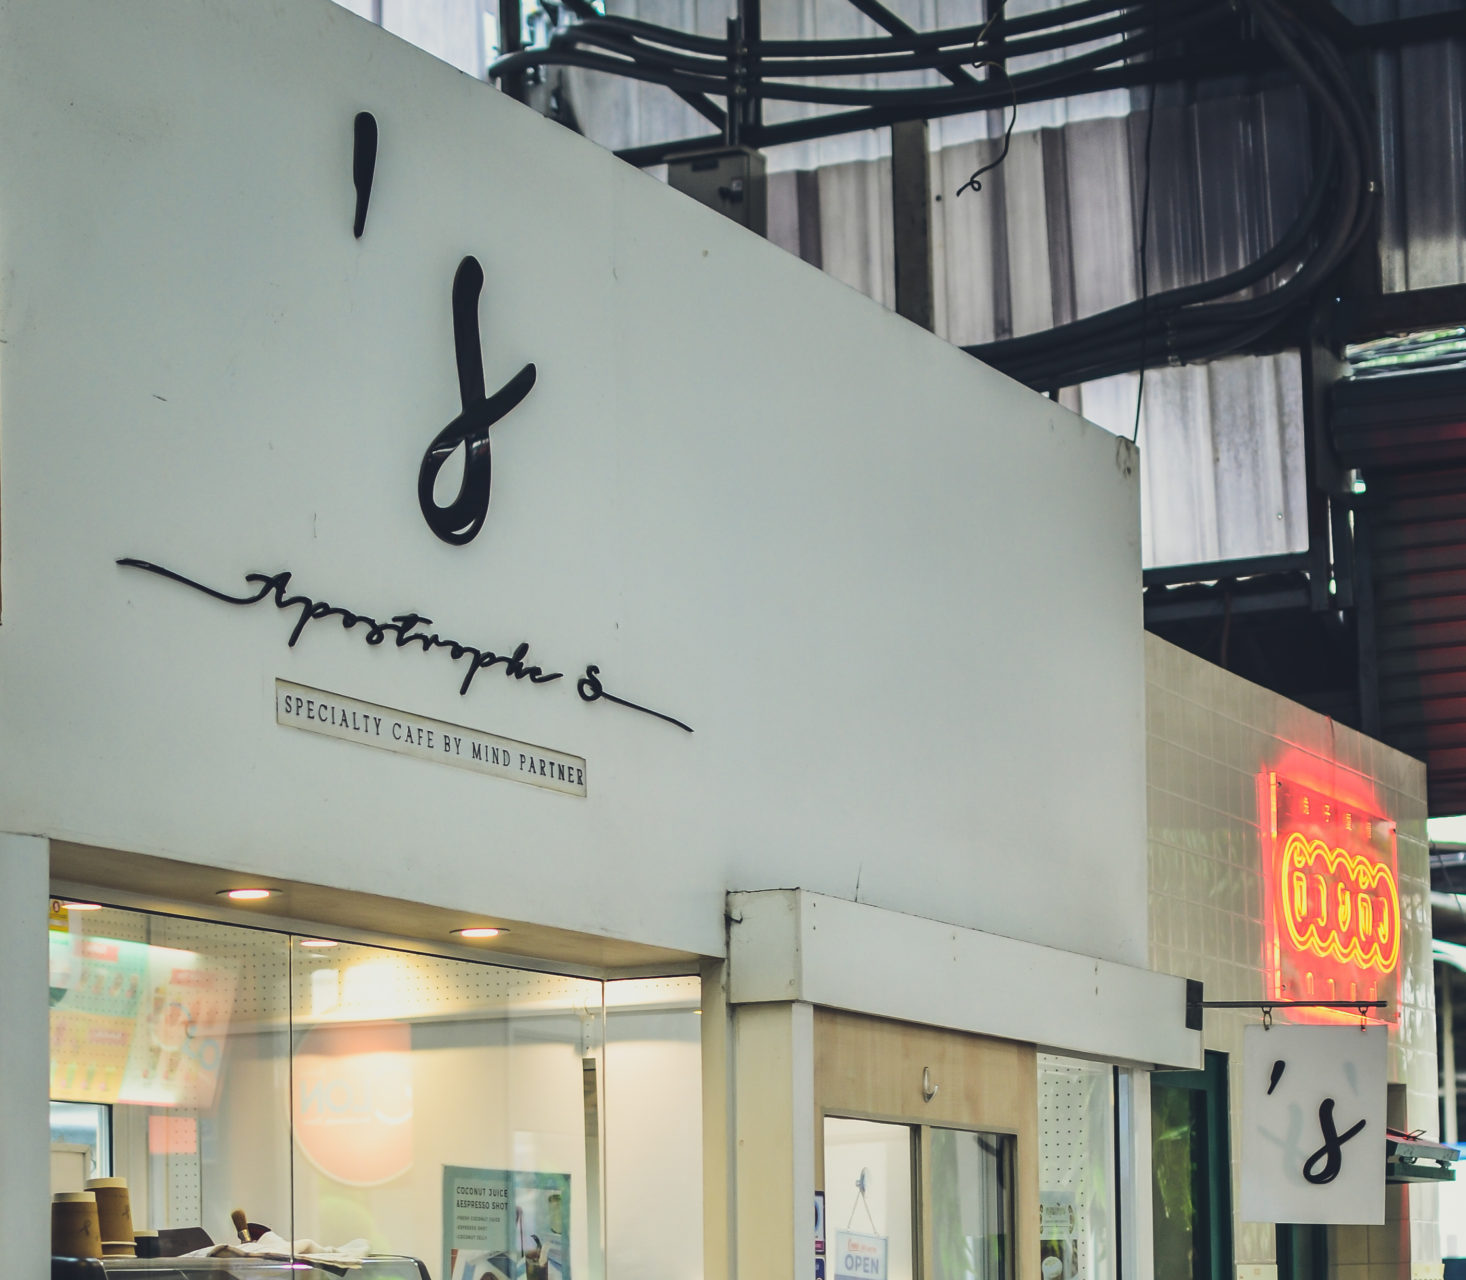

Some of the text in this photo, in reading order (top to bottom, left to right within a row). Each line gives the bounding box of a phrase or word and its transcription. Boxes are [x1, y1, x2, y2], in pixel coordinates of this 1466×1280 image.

[115, 557, 564, 696] Apostrophe
[285, 694, 584, 786] SPECIALTY CAFE BY MIND PARTNER
[456, 1187, 508, 1198] COCONUT JUICE
[456, 1200, 508, 1211] &ESPRESSO SHOT
[844, 1253, 879, 1275] OPEN
